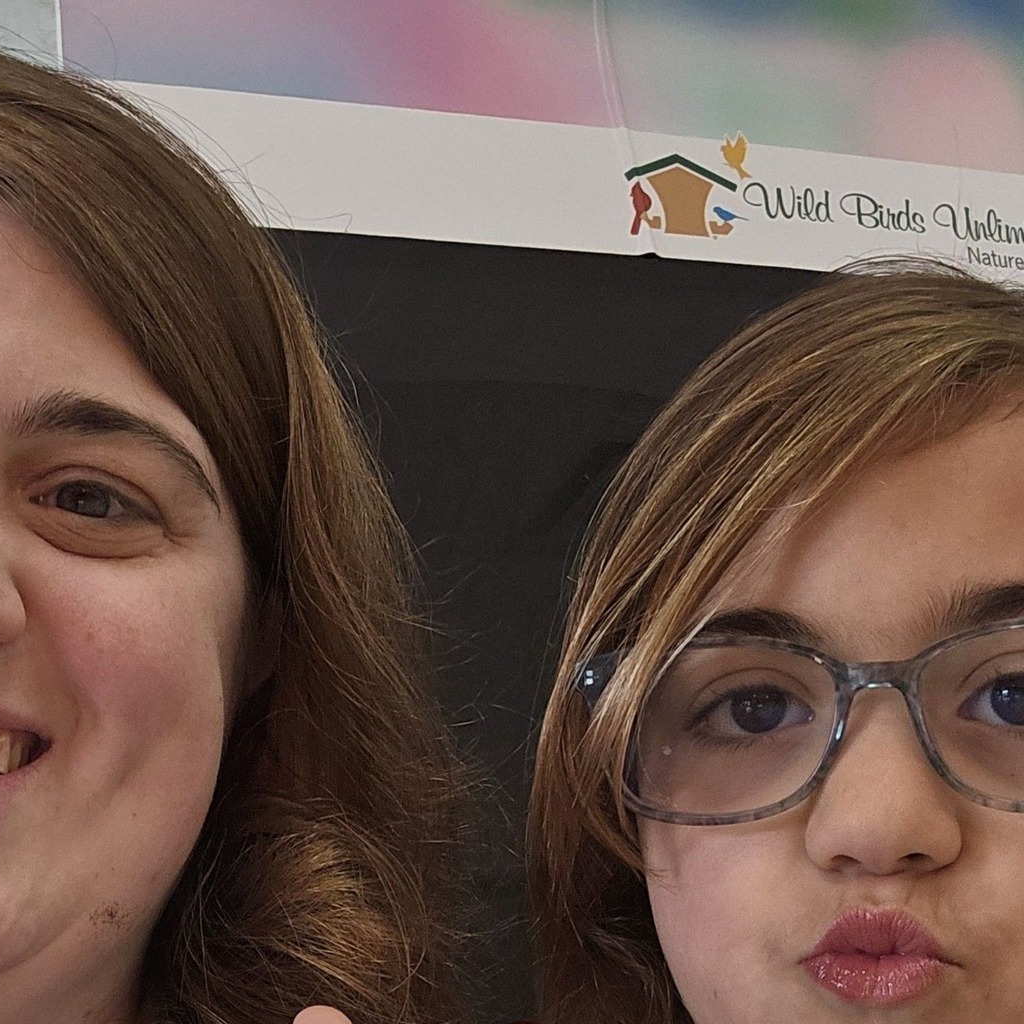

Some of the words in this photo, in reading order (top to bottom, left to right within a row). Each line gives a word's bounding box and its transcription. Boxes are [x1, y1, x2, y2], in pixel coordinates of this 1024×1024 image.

[742, 182, 835, 223] Wild
[839, 193, 926, 233] Birds
[967, 246, 1024, 271] Nature
